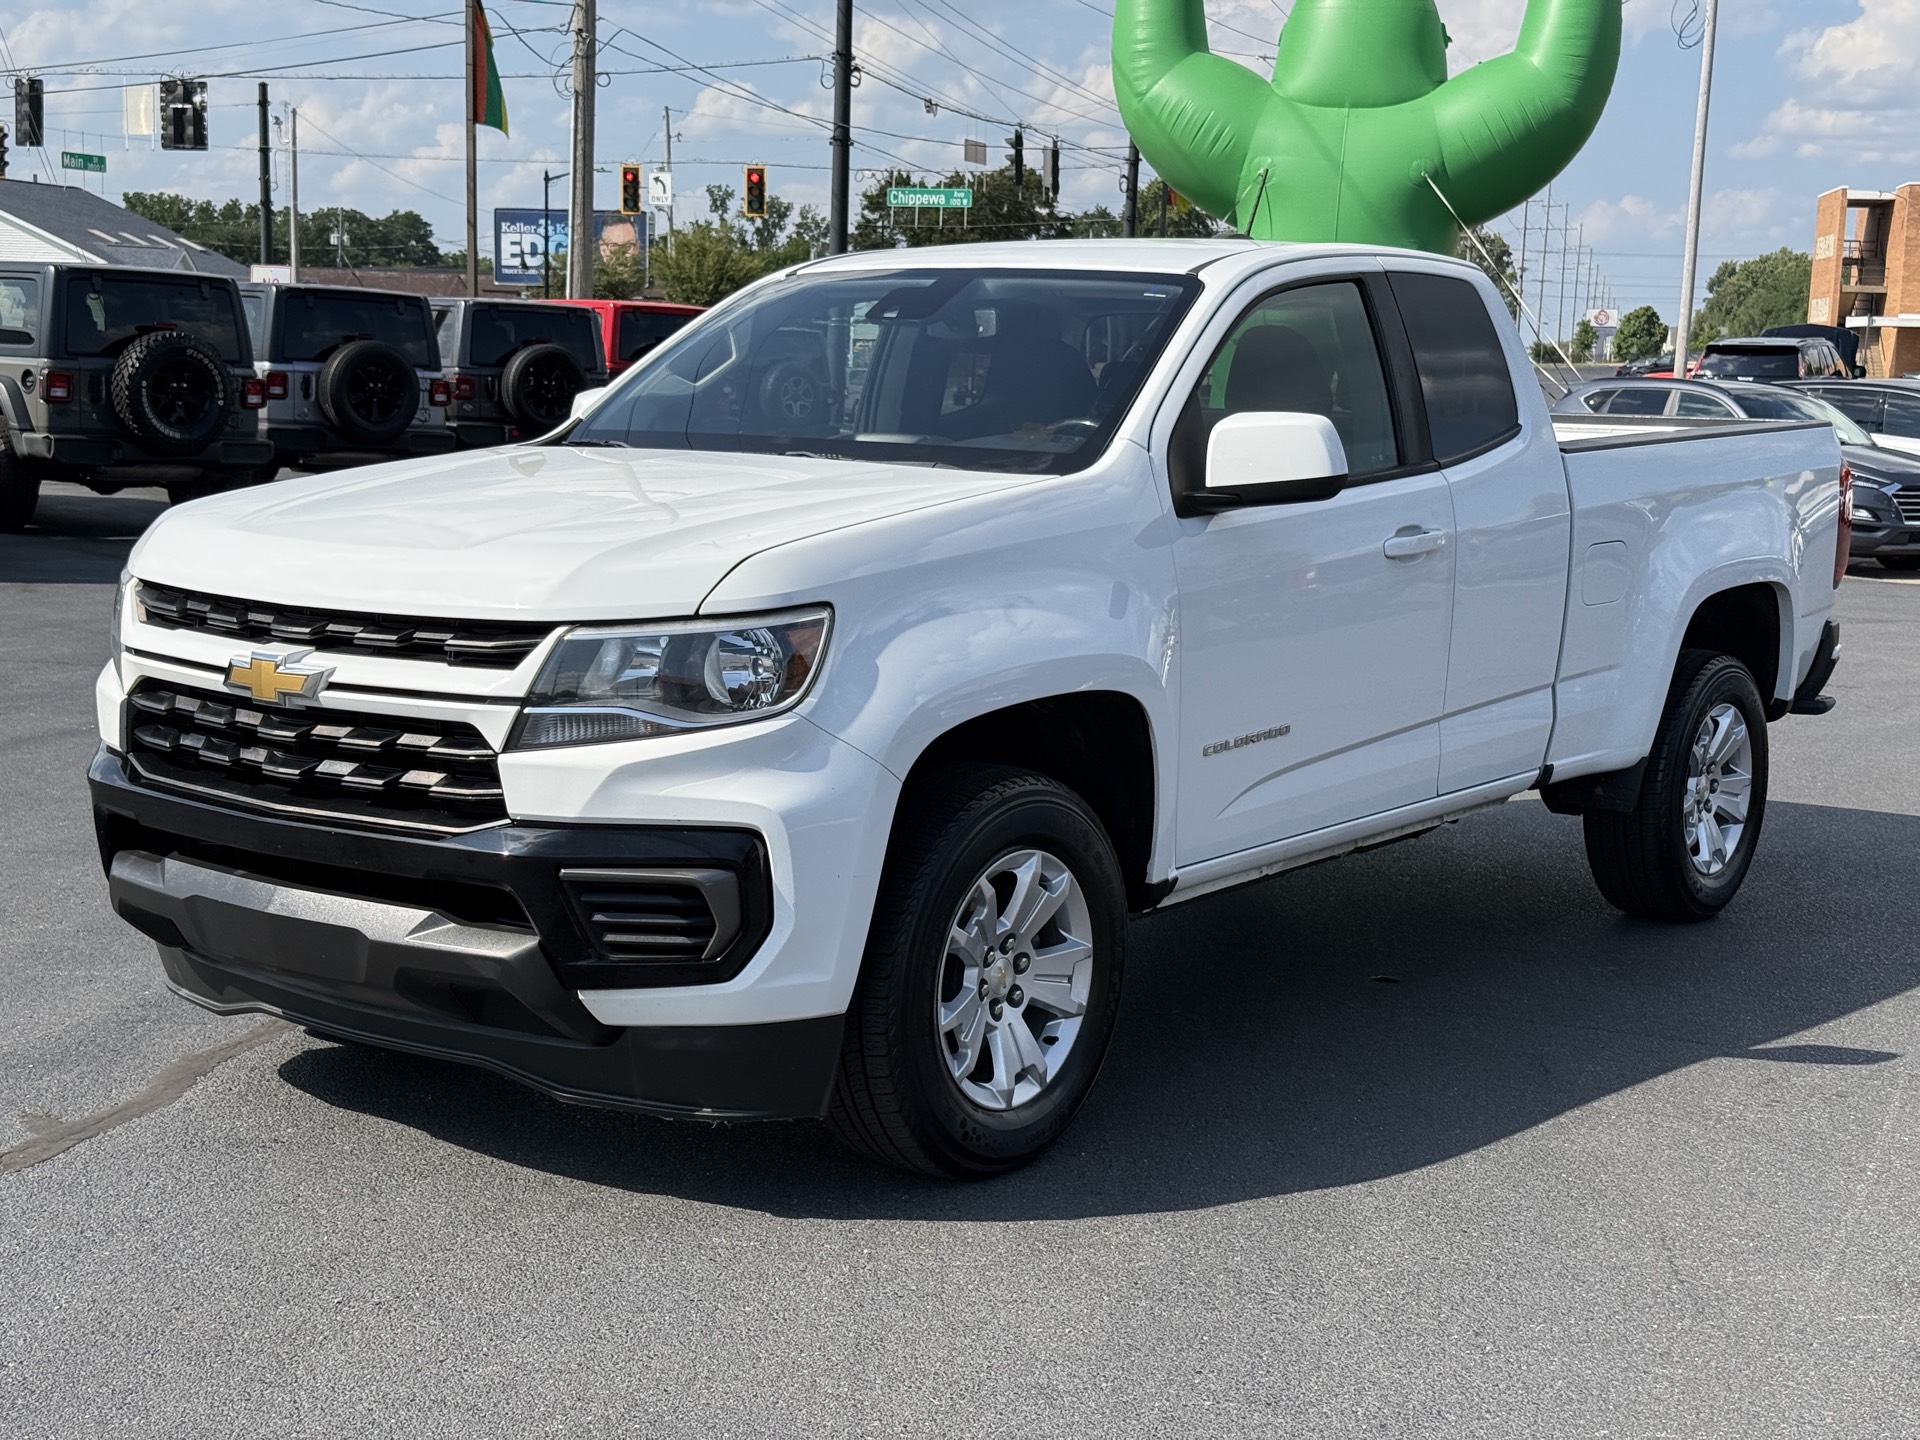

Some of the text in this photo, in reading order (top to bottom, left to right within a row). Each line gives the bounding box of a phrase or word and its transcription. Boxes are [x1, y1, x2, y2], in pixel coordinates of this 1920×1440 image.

[63, 153, 84, 169] Main
[890, 190, 946, 206] Chippewa
[501, 221, 537, 234] Keller
[501, 233, 569, 267] EDG
[1202, 722, 1291, 757] COLORADO
